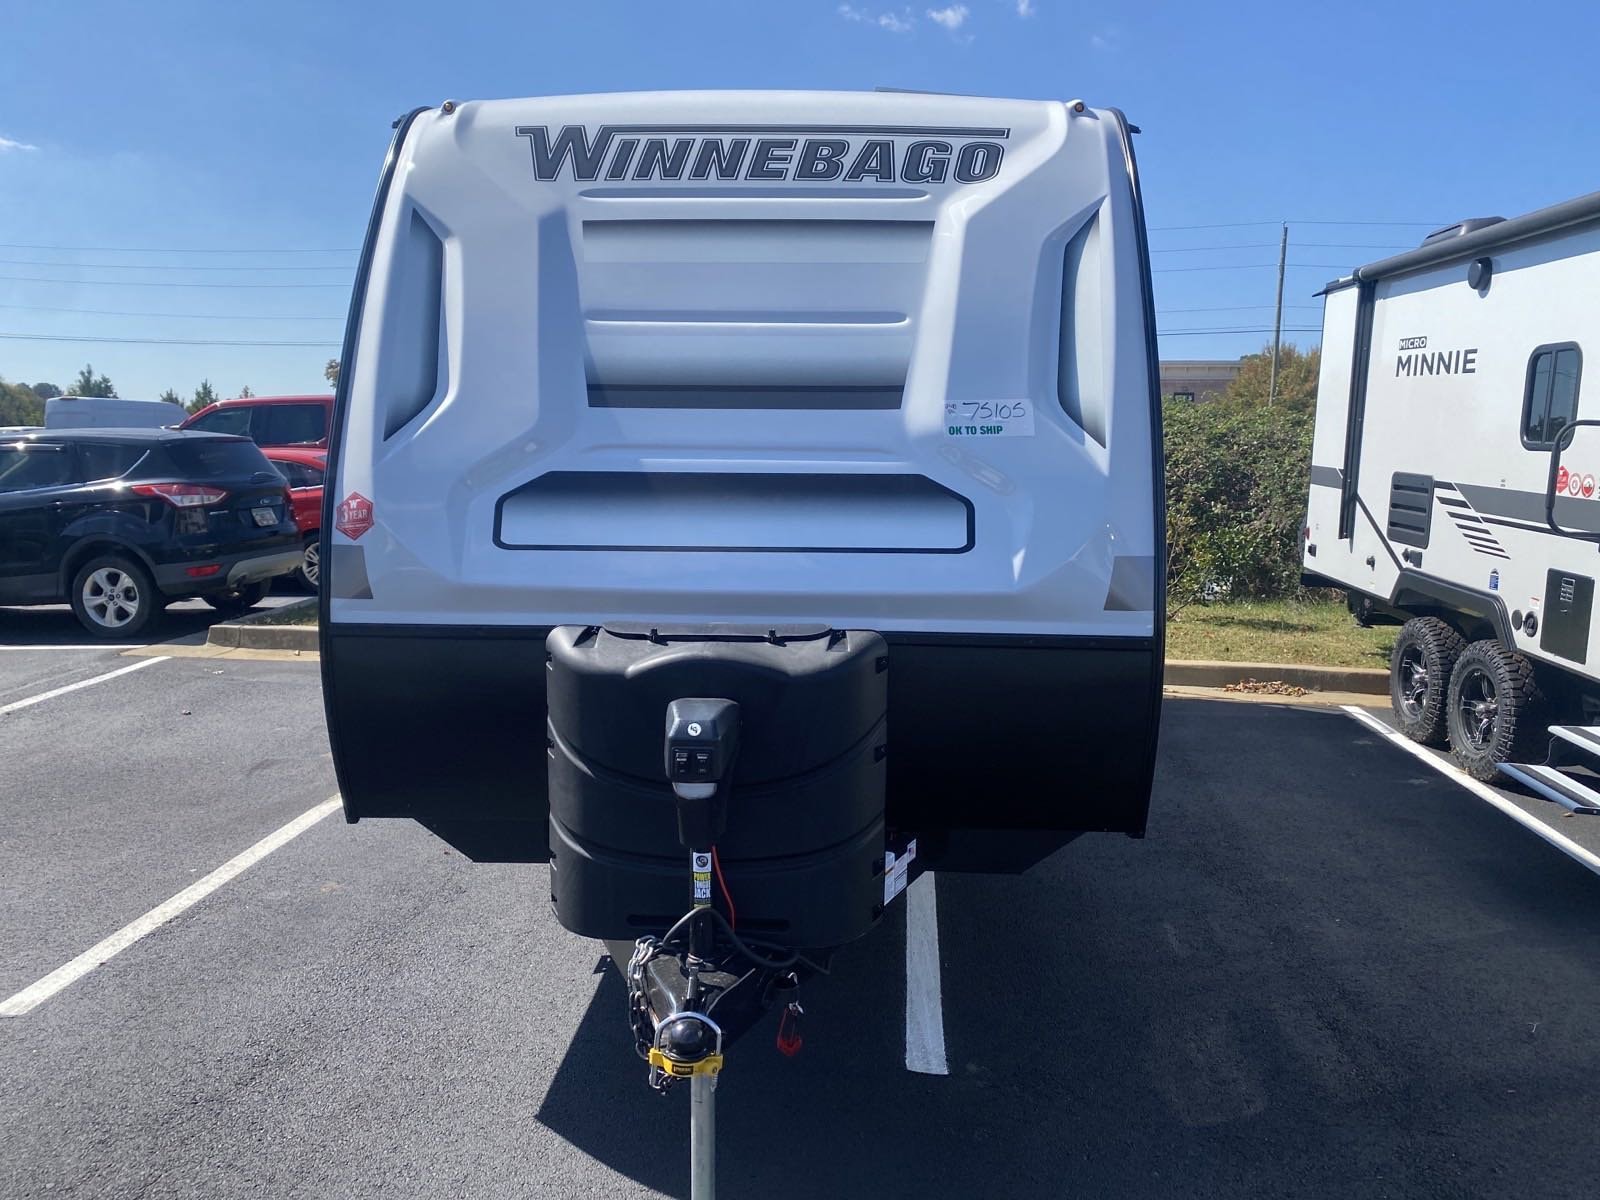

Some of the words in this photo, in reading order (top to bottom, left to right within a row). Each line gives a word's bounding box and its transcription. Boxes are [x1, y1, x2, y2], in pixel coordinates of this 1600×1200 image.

[515, 125, 1011, 184] WINNEBAGO
[1399, 337, 1427, 350] MICRO
[1395, 348, 1478, 378] MINNIE
[948, 425, 963, 436] OK
[964, 425, 977, 436] TO
[979, 425, 1004, 436] SHIP
[349, 509, 368, 521] YEAR
